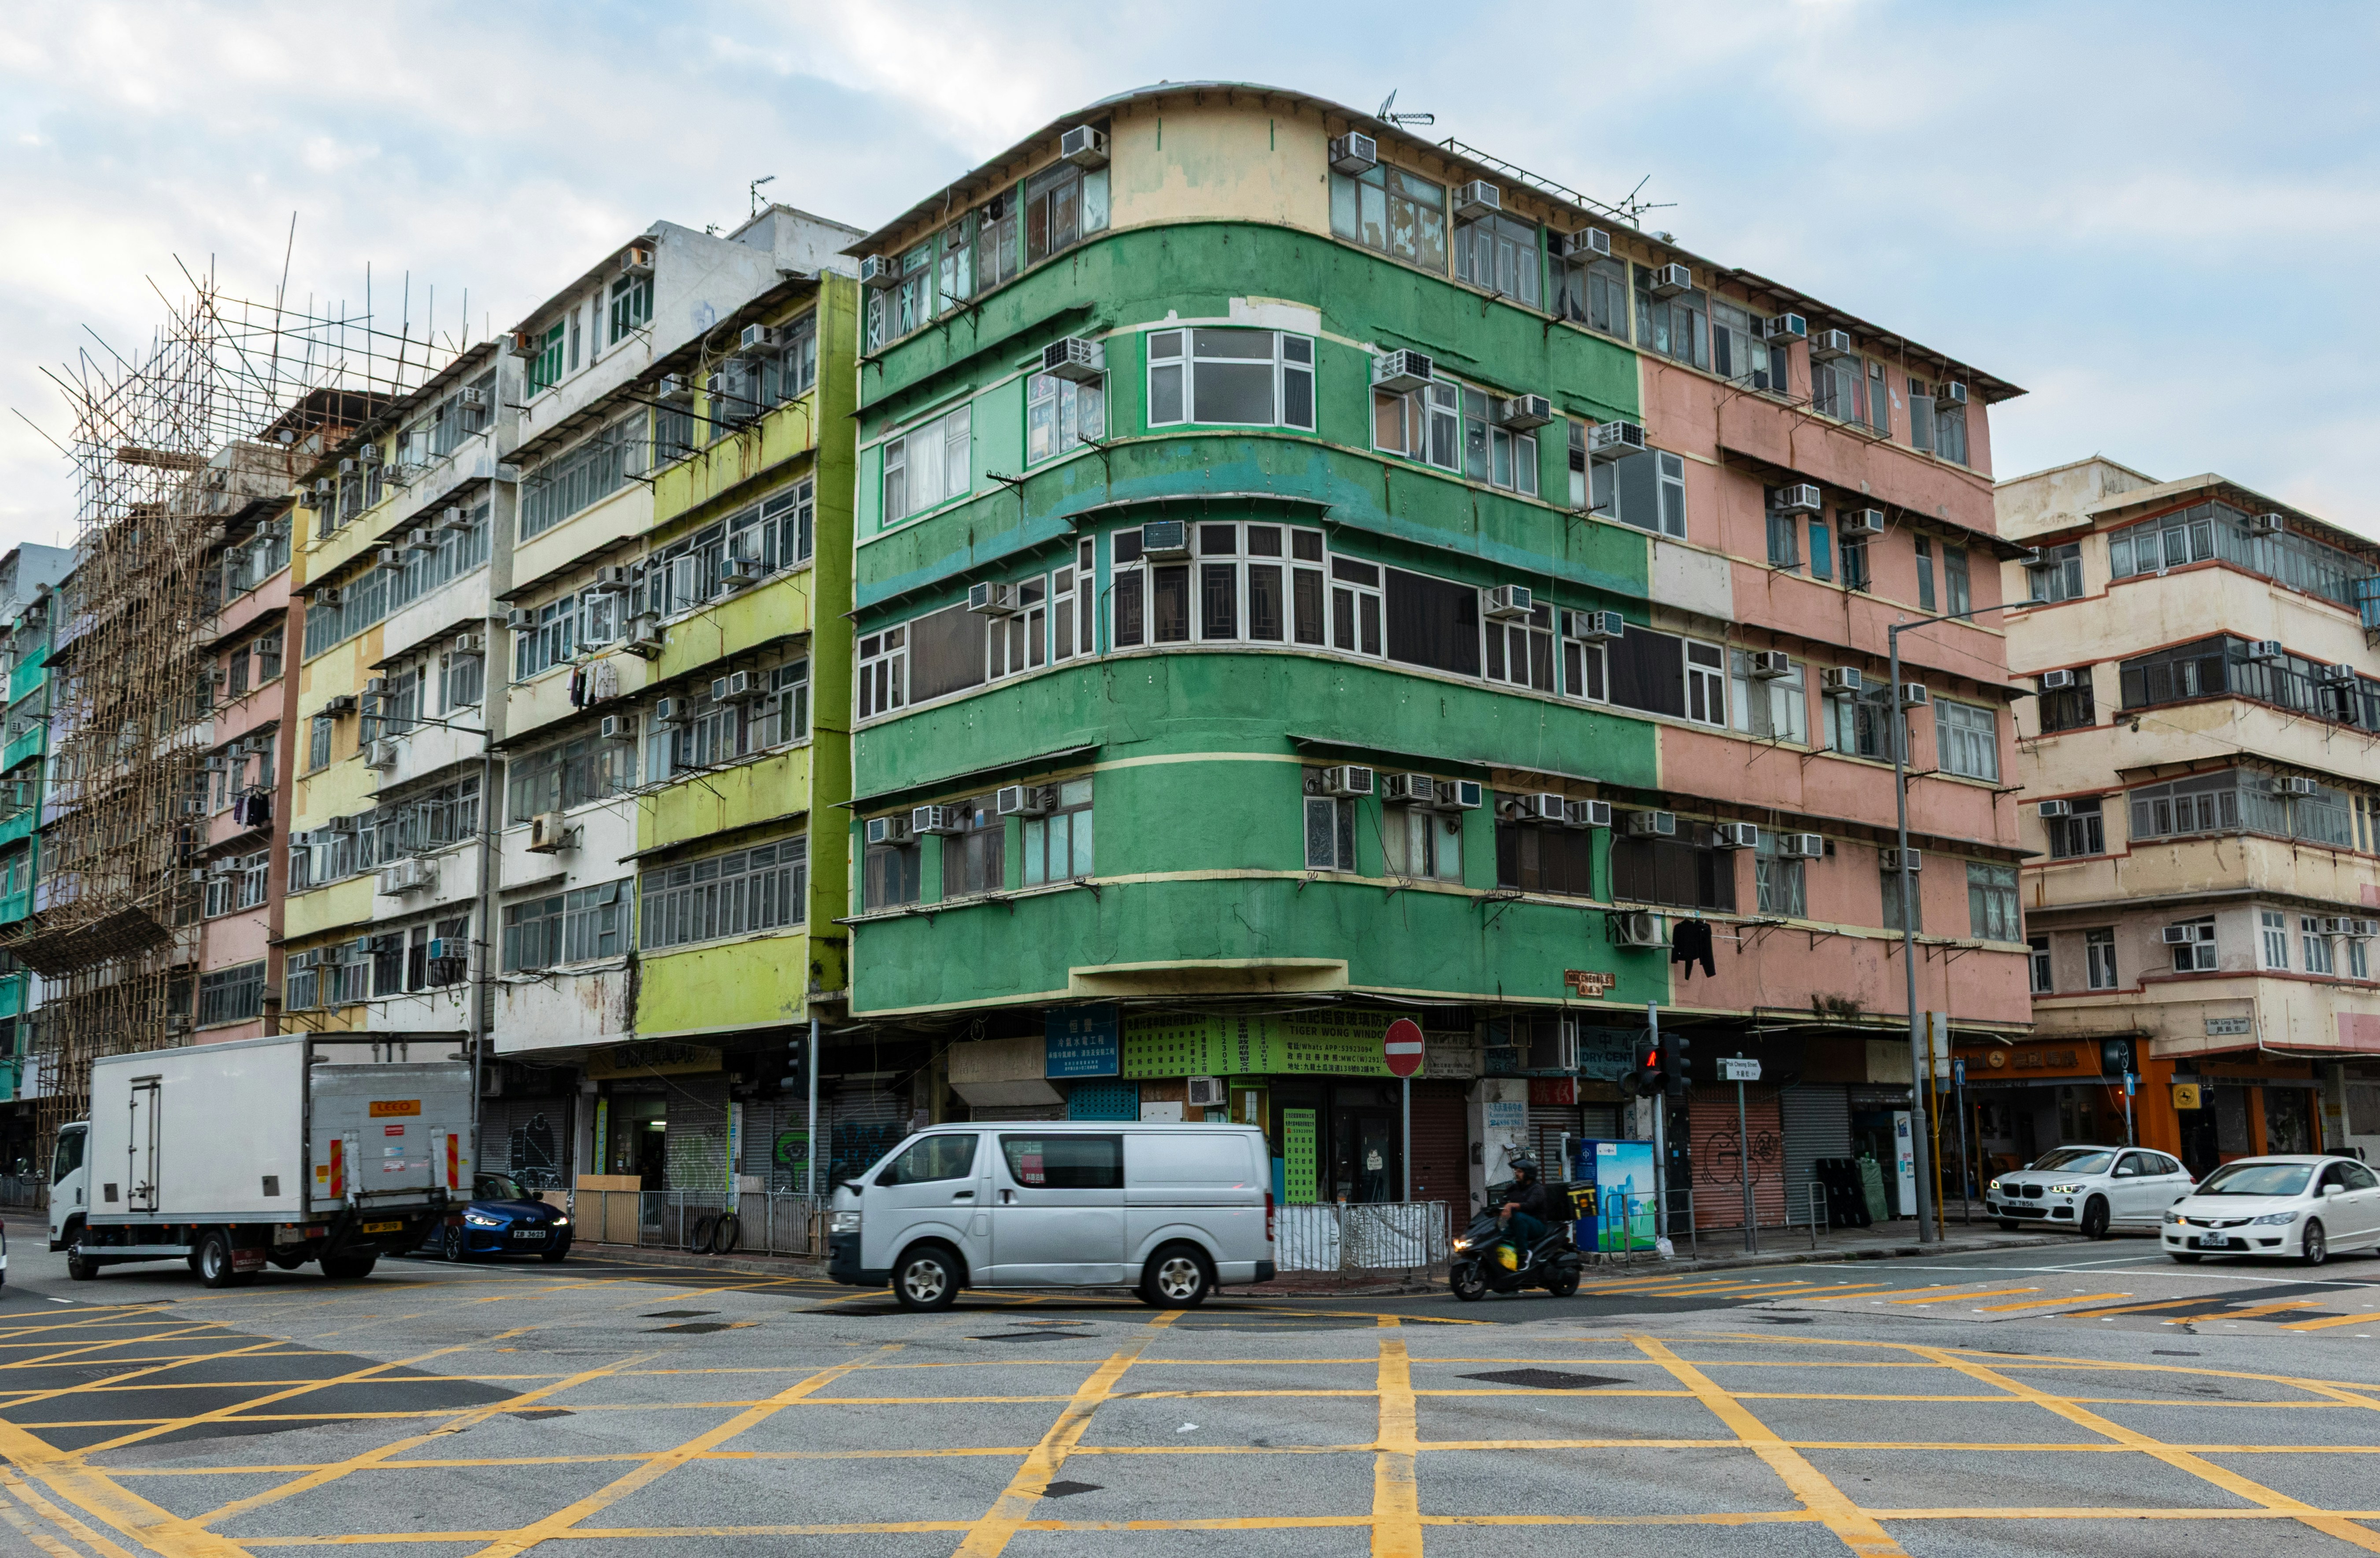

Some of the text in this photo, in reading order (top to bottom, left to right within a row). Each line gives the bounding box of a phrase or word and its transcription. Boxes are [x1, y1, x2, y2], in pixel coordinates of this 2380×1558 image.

[1282, 1010, 1418, 1027] 王信記鋁窗玻璃防水
[1290, 1026, 1317, 1035] TIGER
[1322, 1028, 1349, 1037] WONG
[1058, 1035, 1104, 1047] 冷氣水電工程
[1287, 1042, 1372, 1053] 電話/Whats APP:53923094
[1606, 1052, 1633, 1062] CENT
[1534, 1079, 1571, 1102] 洗衣
